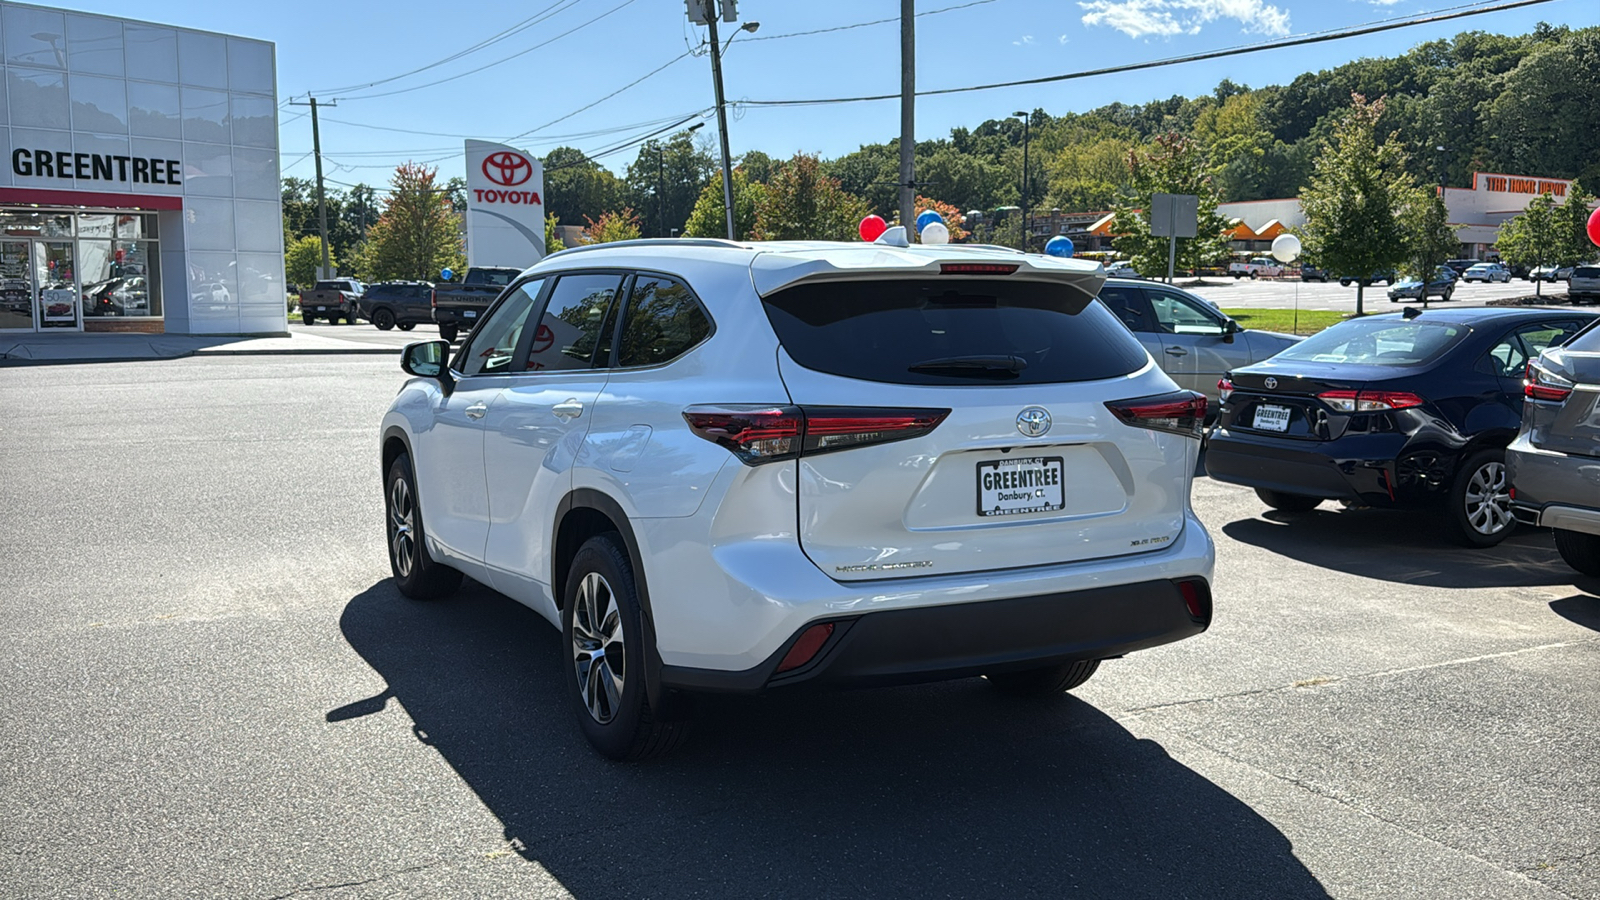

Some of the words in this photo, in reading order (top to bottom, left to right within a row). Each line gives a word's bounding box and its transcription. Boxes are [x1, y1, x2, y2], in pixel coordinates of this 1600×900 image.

[12, 148, 182, 185] GREENTREE
[1486, 177, 1507, 192] THE
[1508, 178, 1536, 194] HOME
[1538, 181, 1567, 196] DEPOT
[473, 189, 542, 205] TOYOTA
[1257, 409, 1288, 420] GREENTREE
[984, 468, 1058, 491] GREENTREE
[998, 490, 1033, 501] Danbury,
[1035, 489, 1045, 498] CT.
[985, 505, 1060, 516] GREENTREE
